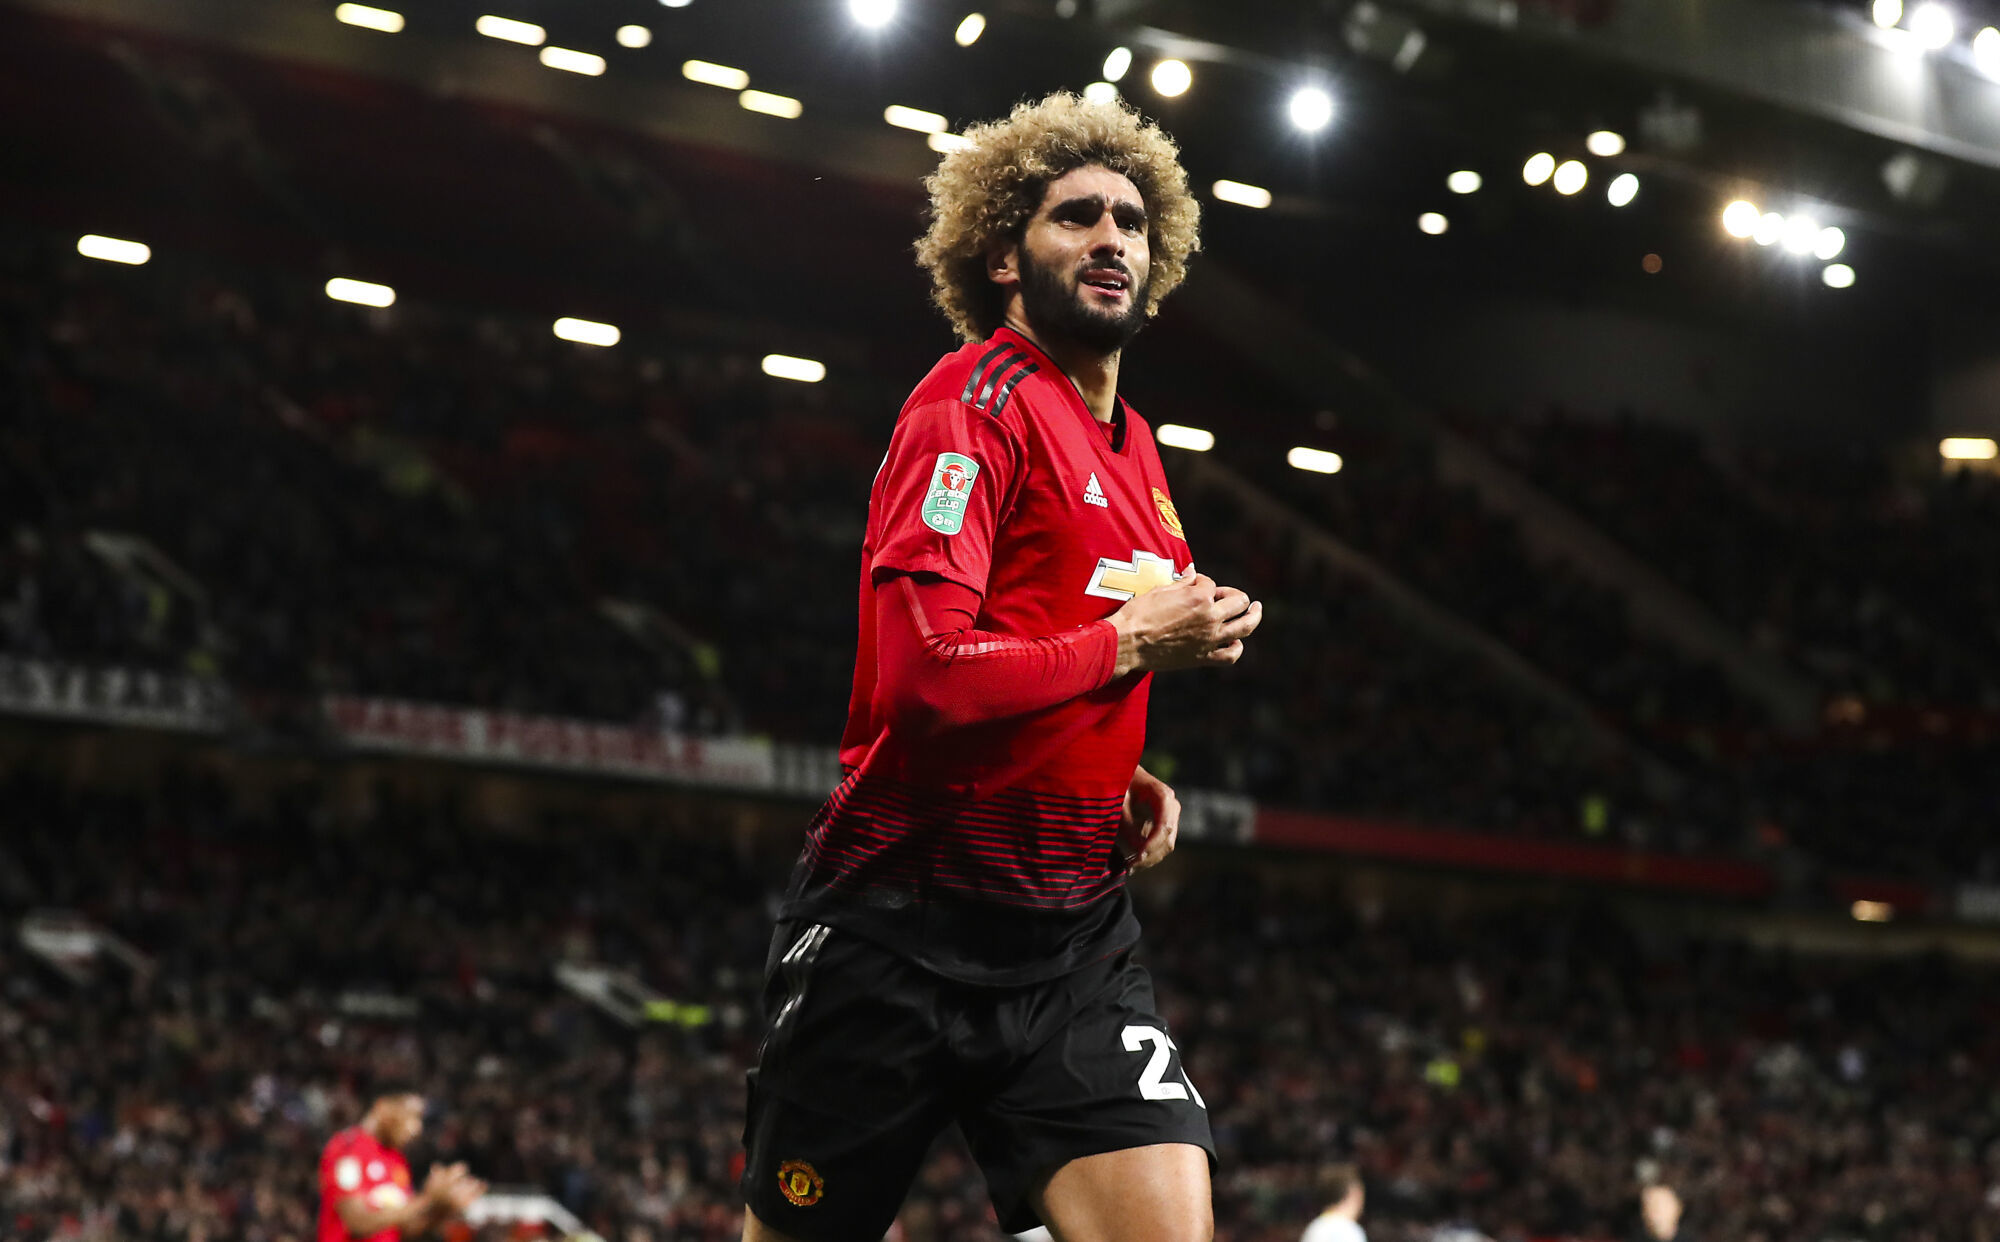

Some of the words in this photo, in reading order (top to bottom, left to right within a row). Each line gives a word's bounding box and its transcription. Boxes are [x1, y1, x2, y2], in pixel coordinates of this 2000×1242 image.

[936, 497, 960, 510] Cup
[1083, 492, 1108, 508] adidas
[1120, 1025, 1206, 1110] 2
